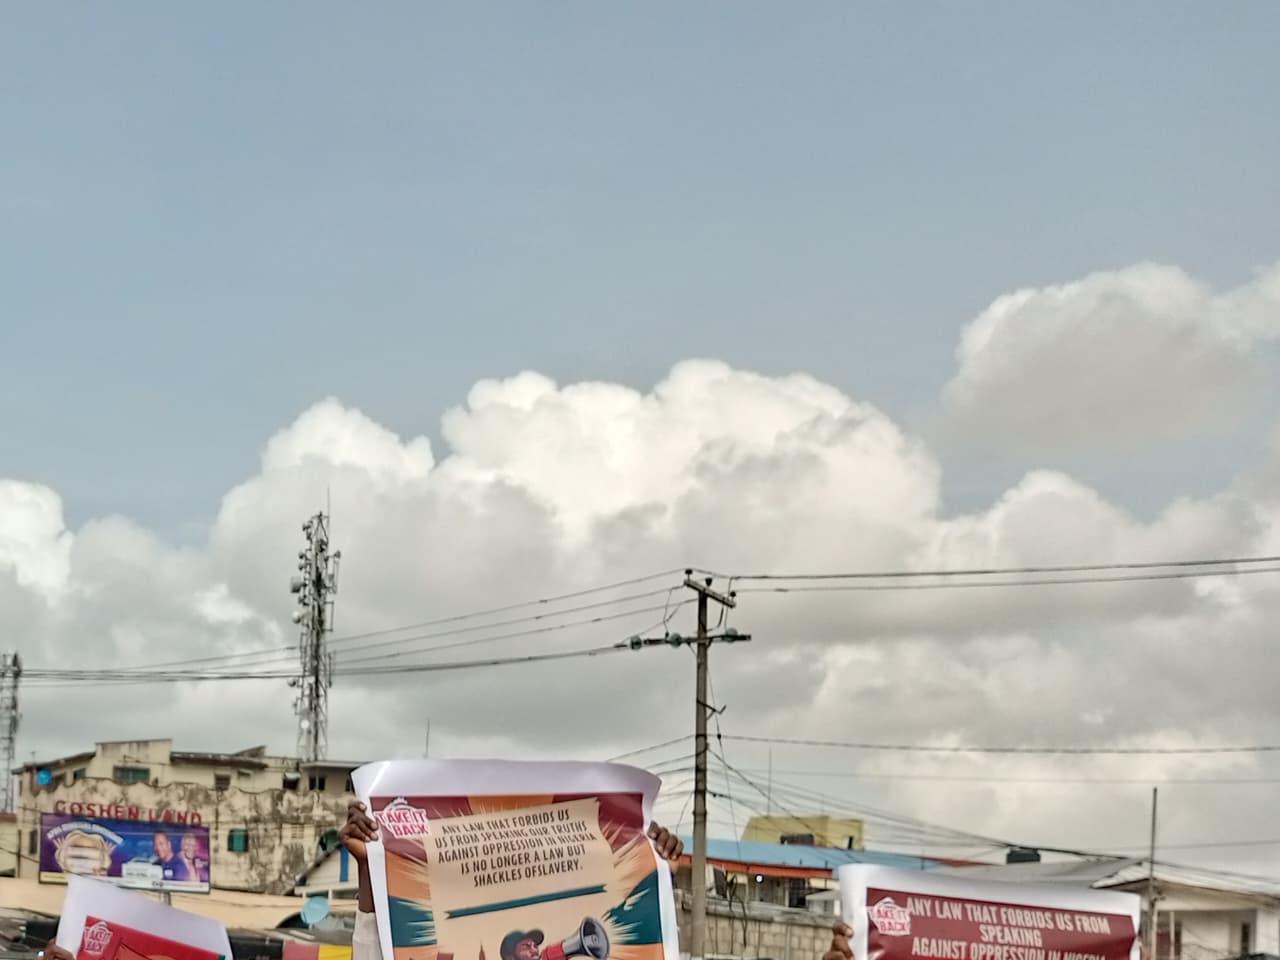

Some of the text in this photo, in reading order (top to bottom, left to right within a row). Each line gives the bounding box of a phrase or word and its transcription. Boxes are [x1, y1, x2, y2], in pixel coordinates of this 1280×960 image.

[55, 799, 202, 827] GOSHEN LAND
[374, 809, 426, 824] TAKE IT
[441, 808, 570, 835] ANY LAW THAT FORBIDS US
[392, 822, 429, 837] BACK
[434, 820, 588, 850] US FROM SPEAKING OUR TRUTHS
[438, 832, 598, 864] AGAINST OPPRESSION IN NIGERIA
[461, 845, 587, 876] IS NO LONGER A LAW BUT
[474, 869, 522, 888] SHACKLES
[906, 897, 1111, 935] ANY LAW THAT FORBIDS US FROM
[911, 937, 967, 959] AGAINST
[979, 924, 1043, 947] SPEAKING
